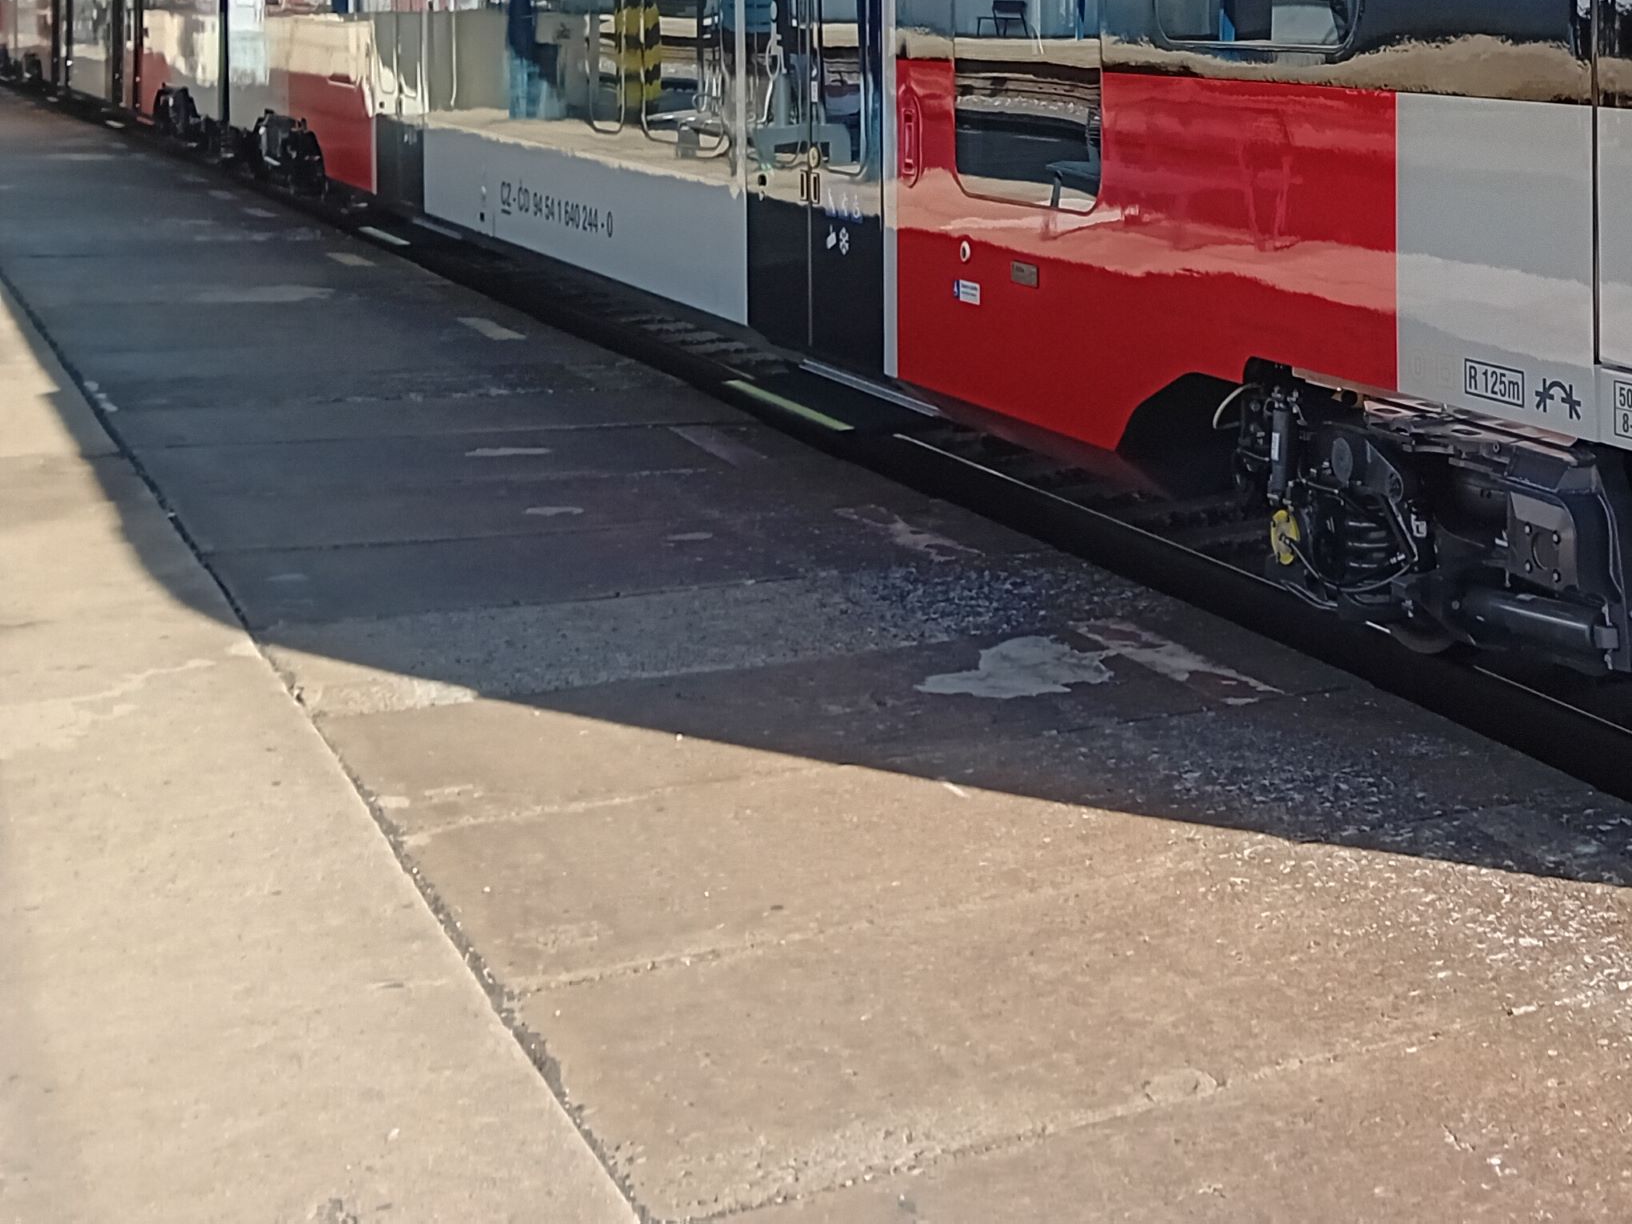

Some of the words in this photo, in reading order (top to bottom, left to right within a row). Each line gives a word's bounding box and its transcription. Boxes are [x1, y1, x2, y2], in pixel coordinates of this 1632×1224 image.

[533, 192, 543, 217] 94
[545, 195, 555, 221] 54
[557, 199, 562, 224] 1
[564, 200, 581, 229] 640
[582, 205, 599, 233] 244
[606, 211, 614, 238] 0
[1468, 365, 1478, 390] R
[1481, 368, 1521, 401] 125m
